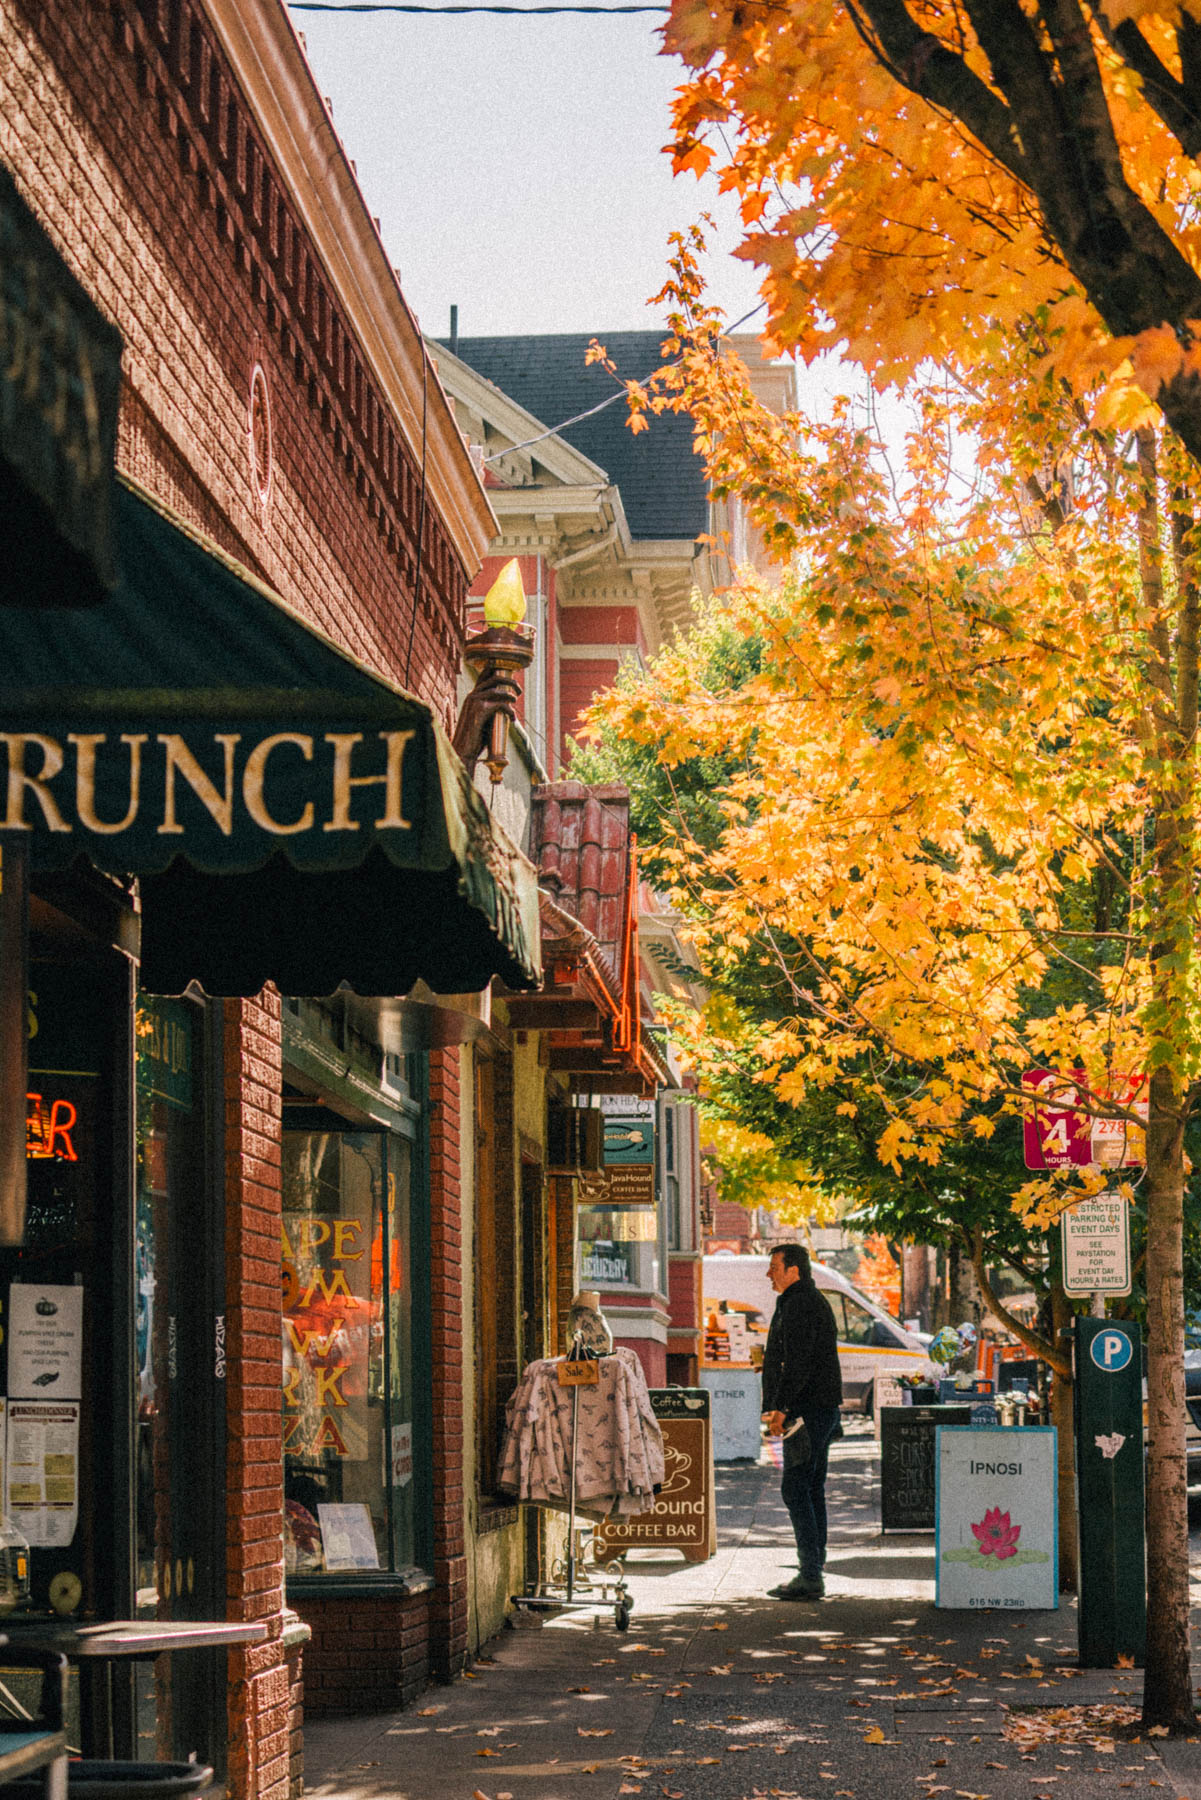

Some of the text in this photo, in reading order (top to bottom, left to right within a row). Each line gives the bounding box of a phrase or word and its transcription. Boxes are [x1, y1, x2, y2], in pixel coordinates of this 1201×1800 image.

[0, 730, 415, 836] RUNCH
[1098, 1120, 1138, 1134] 278
[1043, 1118, 1071, 1153] 4
[611, 1174, 652, 1185] JavaHound
[1073, 1204, 1120, 1212] STRICTED
[1070, 1214, 1105, 1223] PARKING
[1071, 1225, 1120, 1234] EVENT DAYS
[1070, 1276, 1093, 1284] HOURS
[1102, 1276, 1124, 1284] RATES
[1104, 1336, 1122, 1365] P
[566, 1365, 583, 1377] Sale
[714, 1390, 746, 1399] ETHER
[651, 1395, 683, 1408] Coffee
[970, 1460, 1022, 1475] IPNOSI
[605, 1524, 697, 1537] COFFEE BAR
[969, 1598, 985, 1606] 616
[988, 1598, 1001, 1606] NW
